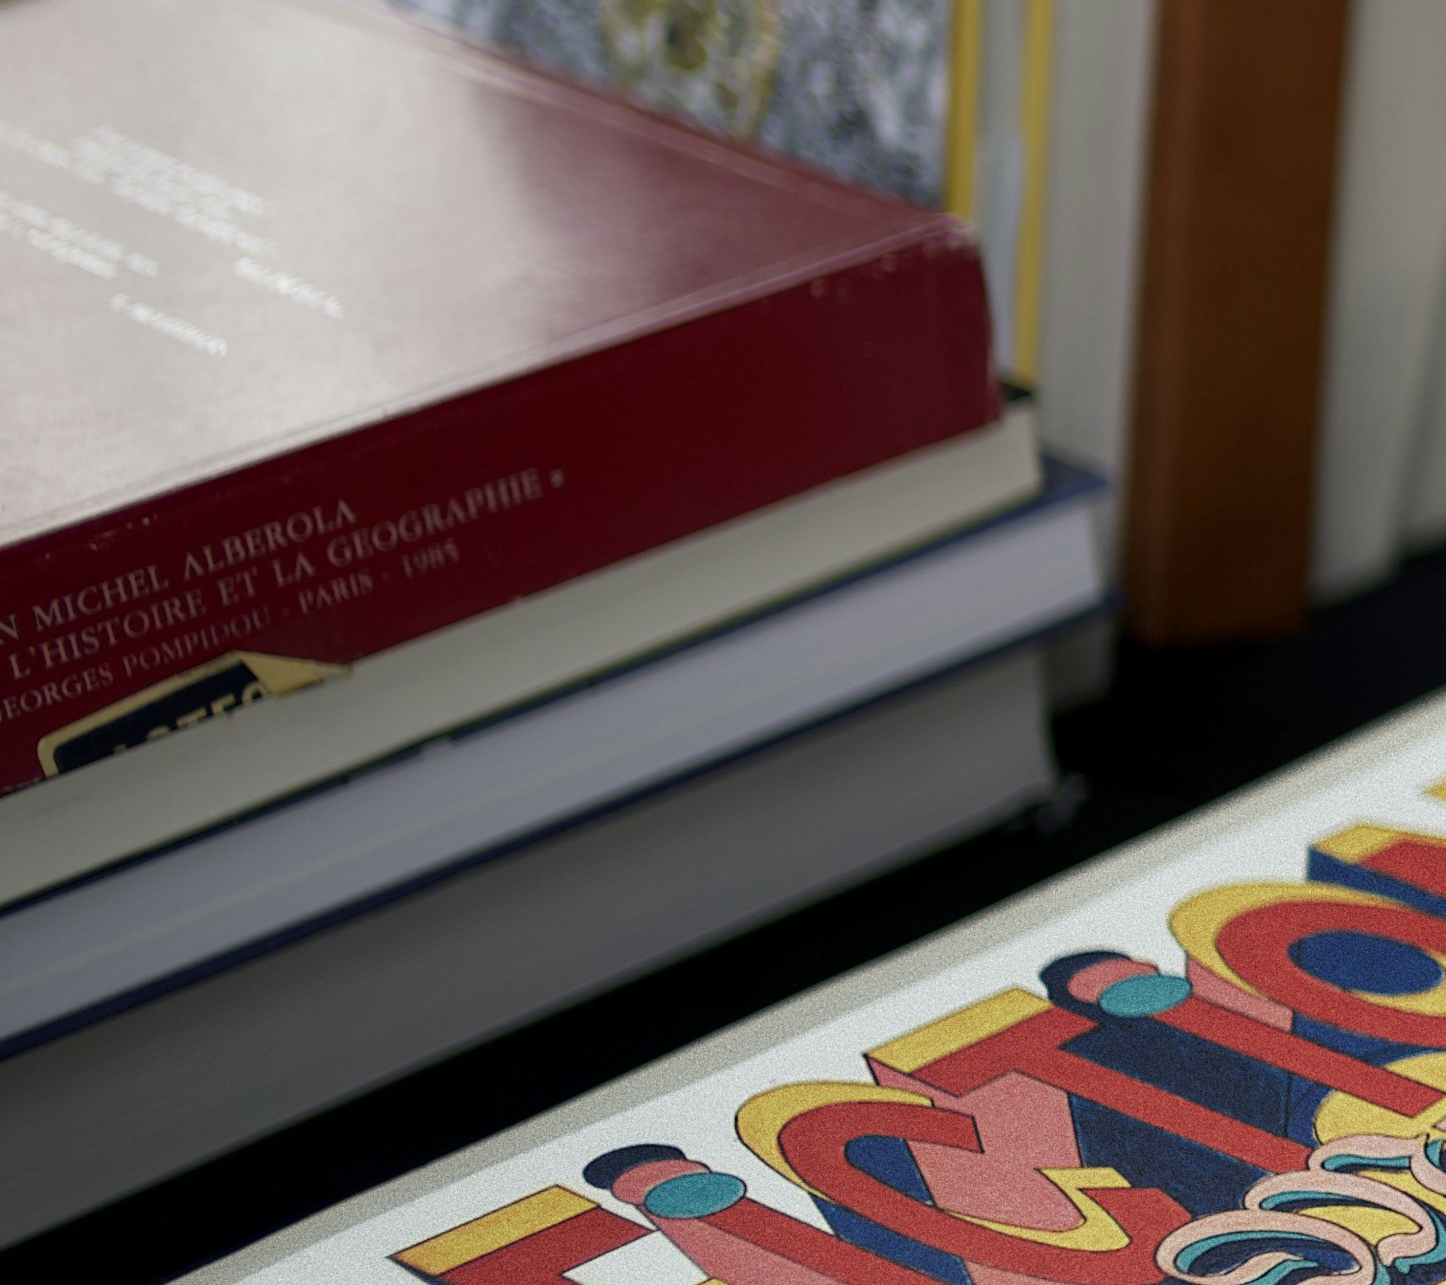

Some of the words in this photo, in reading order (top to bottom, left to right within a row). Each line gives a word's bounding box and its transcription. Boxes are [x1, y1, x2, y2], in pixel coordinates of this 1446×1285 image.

[9, 593, 208, 681] L'HISTOIRE
[217, 573, 260, 607] ET
[274, 551, 316, 589] LA
[33, 563, 170, 632] MICHEL
[182, 497, 360, 580] ALBEROLA
[0, 660, 116, 724] EORGES
[123, 604, 273, 677] POMPIDOU
[298, 567, 375, 616] PARIS
